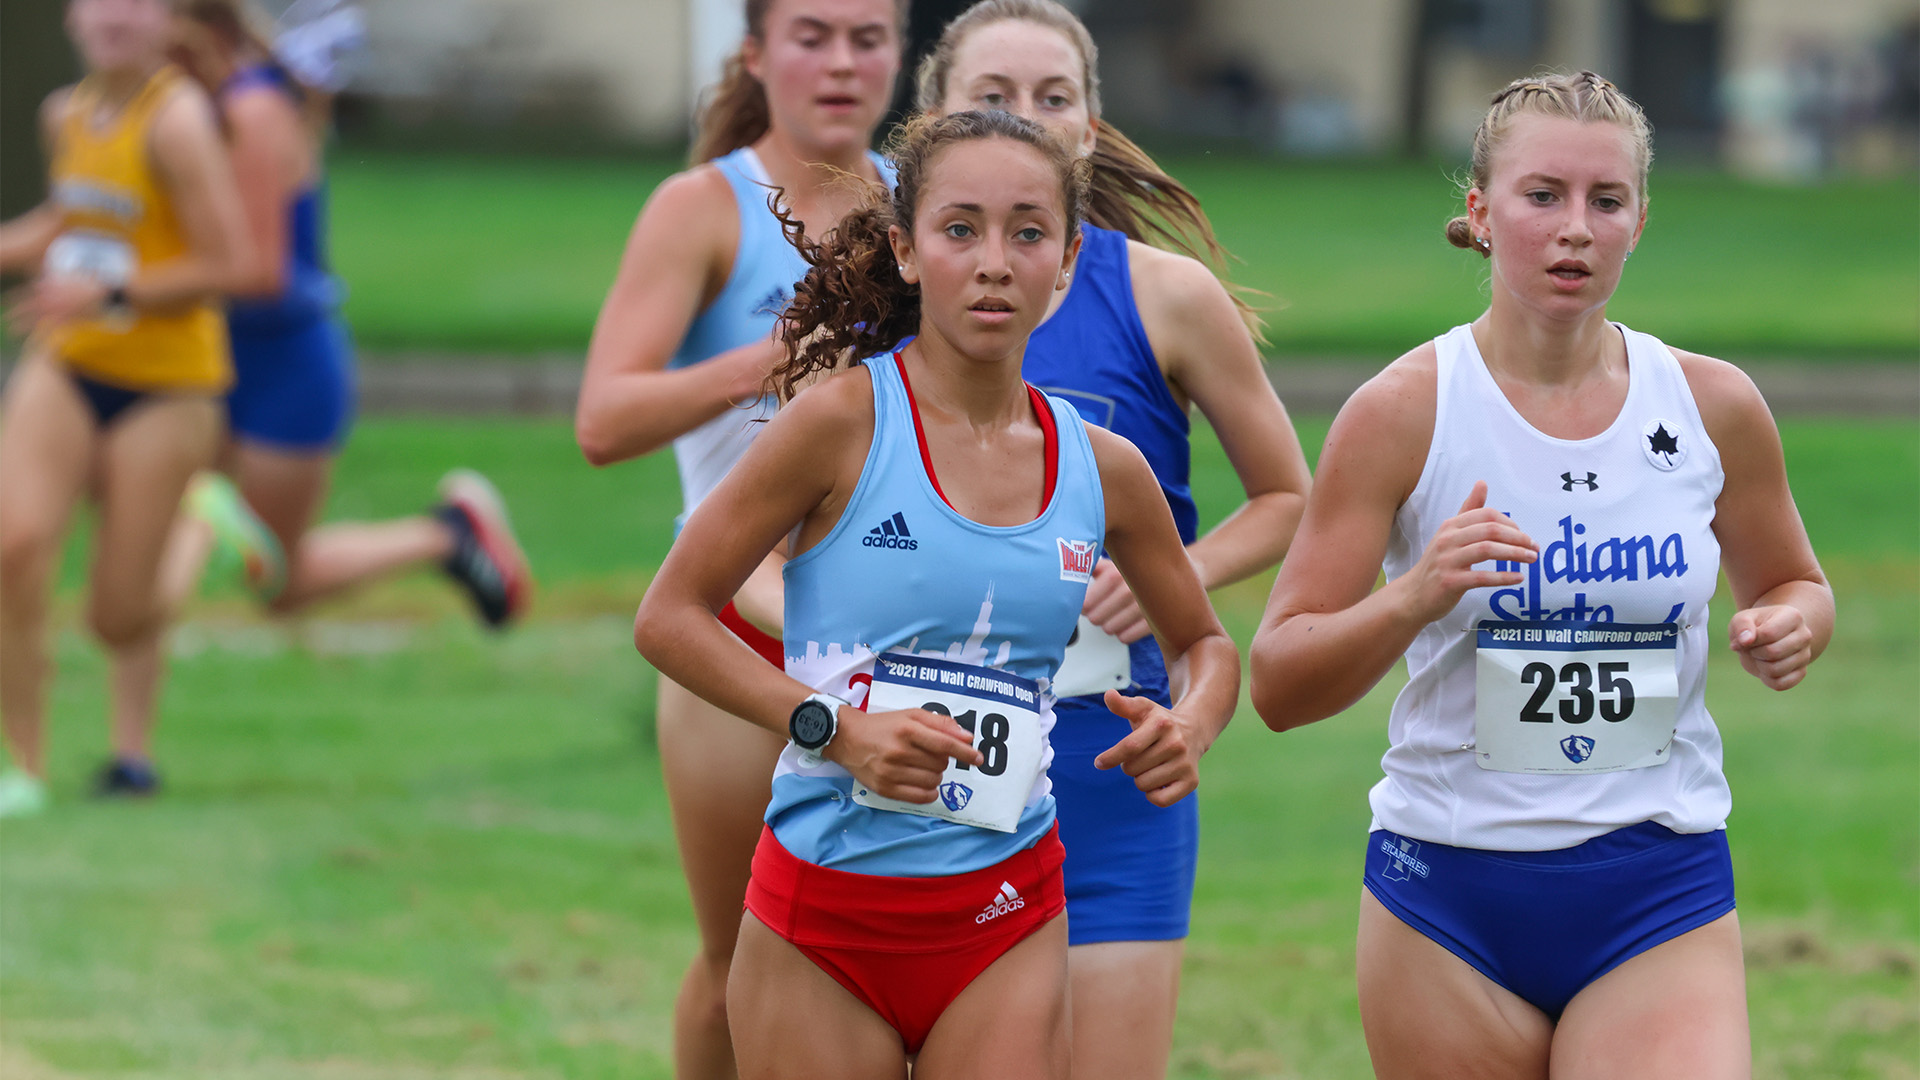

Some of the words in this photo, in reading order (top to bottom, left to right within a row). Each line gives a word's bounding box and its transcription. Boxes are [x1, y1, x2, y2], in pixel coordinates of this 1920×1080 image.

[862, 533, 919, 551] adidas
[1060, 542, 1095, 574] VALLEY
[1074, 544, 1086, 552] THE
[1492, 628, 1521, 642] 2021
[1524, 629, 1543, 643] EIU
[1545, 629, 1572, 644] Walt
[1574, 630, 1631, 644] CRAWFORD
[1633, 630, 1663, 643] open
[888, 662, 917, 679] 2021
[919, 667, 938, 682] EIU
[940, 669, 965, 687] Walt
[966, 674, 1014, 696] CRAWFORD
[1015, 685, 1034, 704] open
[1519, 661, 1636, 724] 235
[920, 702, 1010, 777] 18
[1382, 841, 1428, 876] SYCAMORES
[975, 896, 1025, 925] adidas
